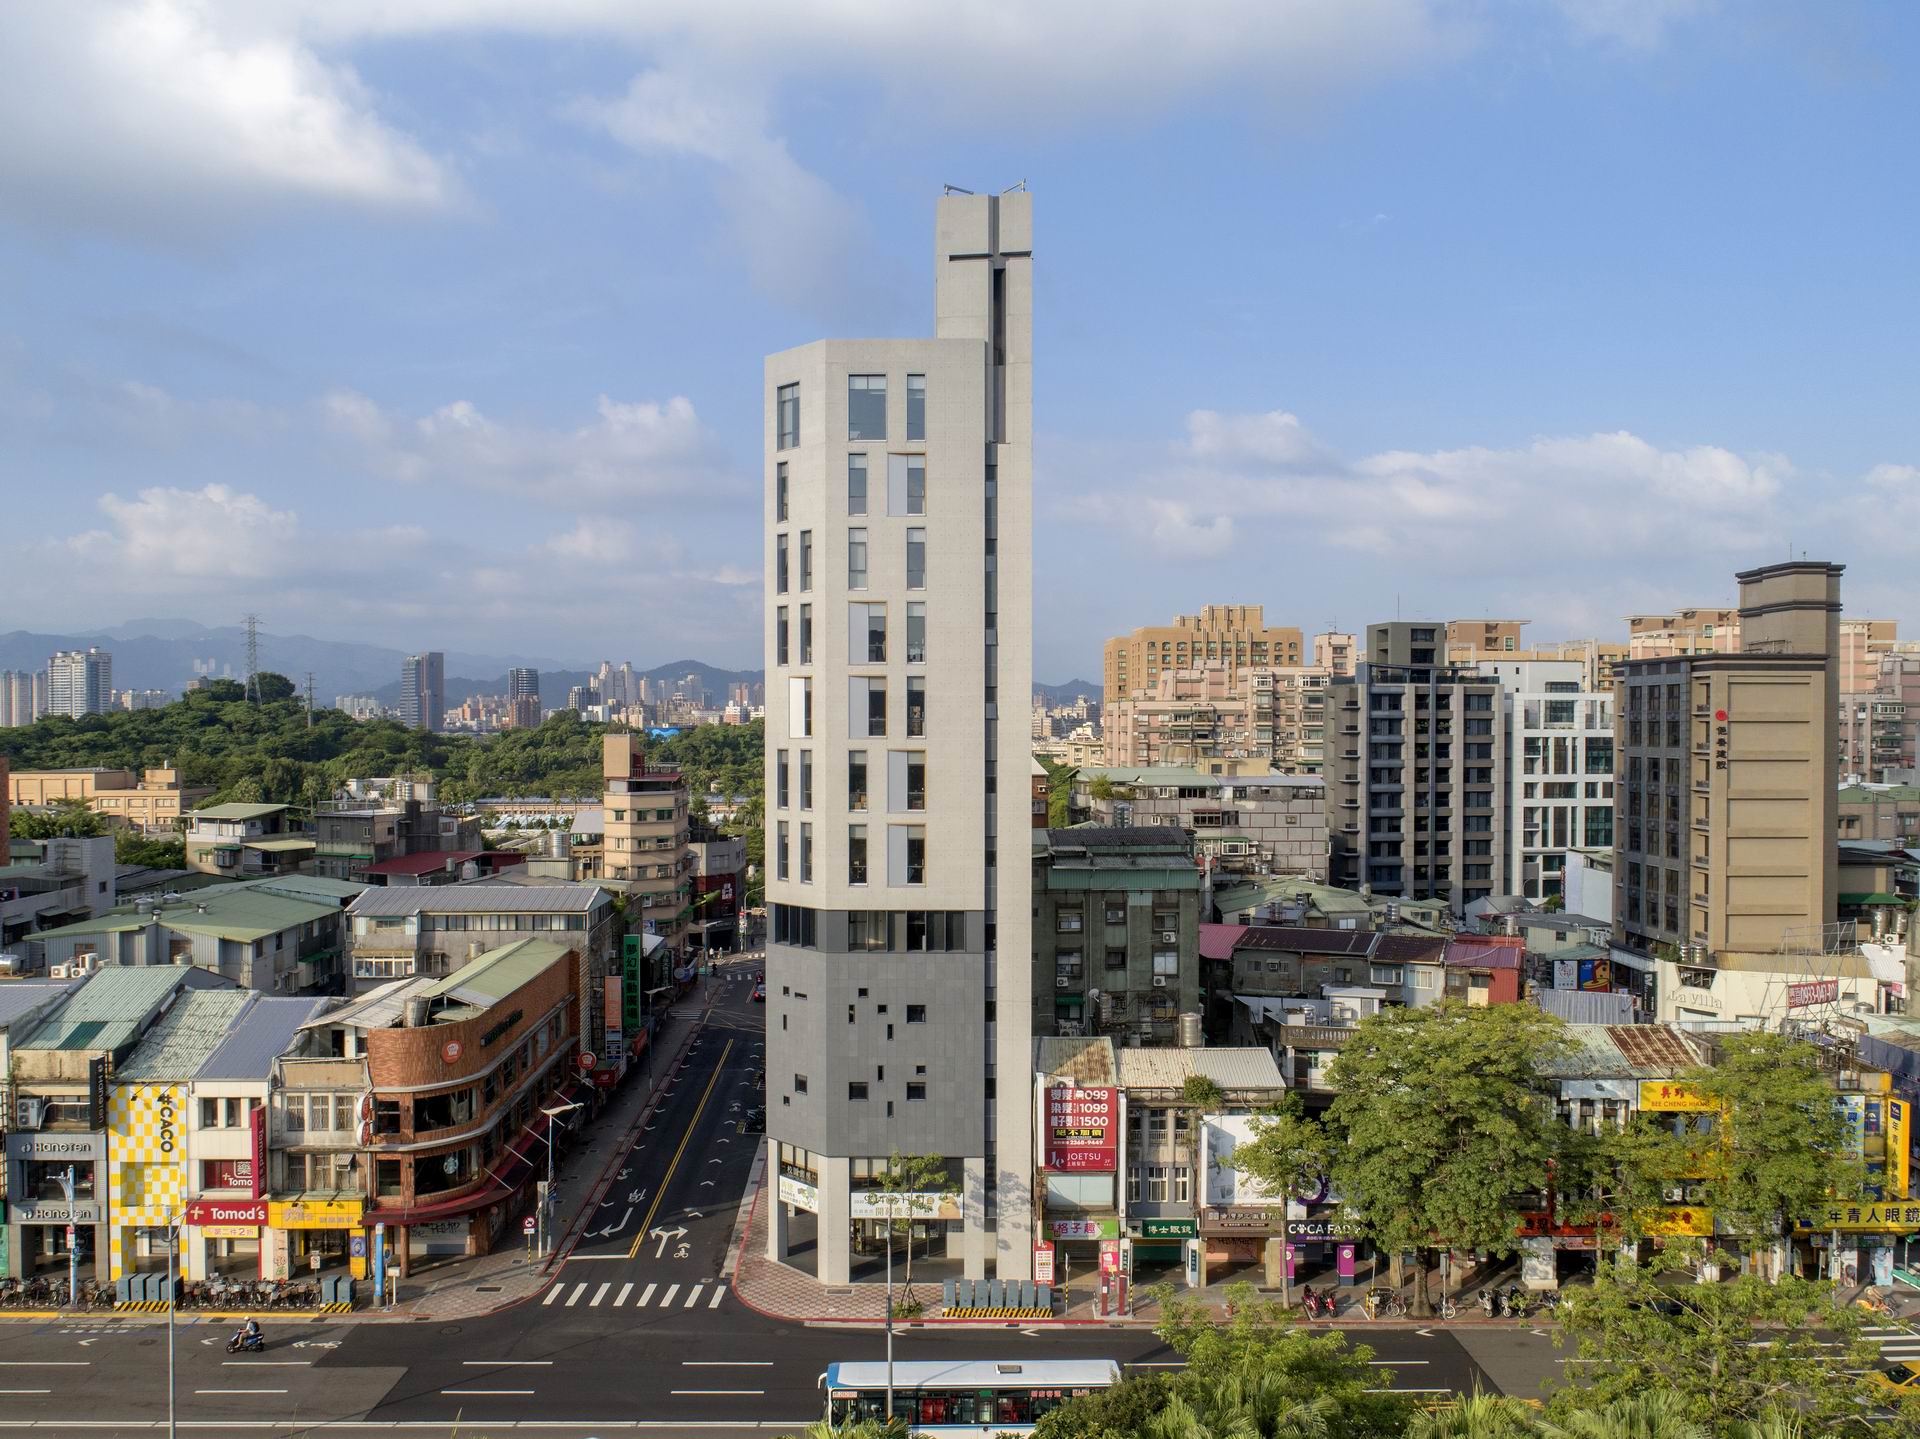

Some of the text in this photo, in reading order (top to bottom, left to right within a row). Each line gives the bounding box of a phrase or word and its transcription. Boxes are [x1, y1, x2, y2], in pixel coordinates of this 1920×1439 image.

[1669, 990, 1722, 1009] La Villa
[1080, 1103, 1109, 1113] 1099
[160, 1094, 174, 1153] #CACO
[1080, 1116, 1109, 1126] 1500
[1067, 1152, 1101, 1161] JOETSU
[228, 1177, 253, 1186] Tomo
[210, 1205, 265, 1220] Tomod's
